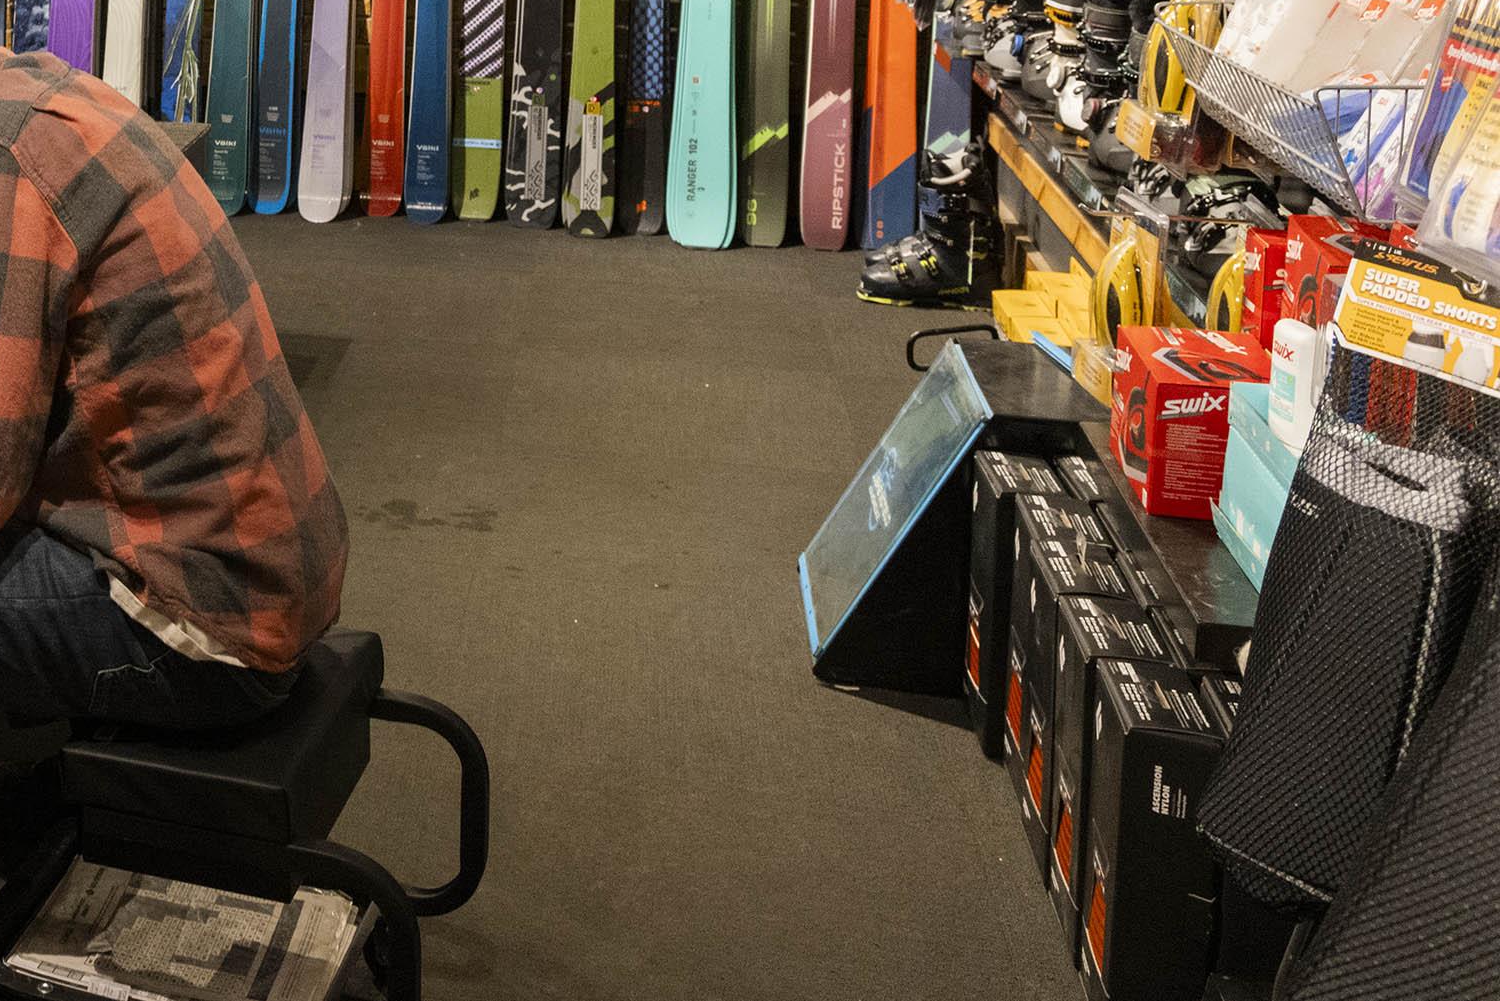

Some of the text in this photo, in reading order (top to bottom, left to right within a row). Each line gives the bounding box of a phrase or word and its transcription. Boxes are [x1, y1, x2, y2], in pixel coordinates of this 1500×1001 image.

[214, 139, 237, 147] Völkl
[371, 138, 395, 147] Völkl
[416, 144, 440, 152] Völkl
[686, 138, 698, 202] RANGER 102
[831, 141, 847, 230] RIPSTICK
[1386, 254, 1440, 275] seirus
[1364, 268, 1421, 294] SUPER
[1360, 280, 1498, 331] PADDED SHORTS
[1273, 340, 1294, 362] swix
[1162, 392, 1227, 416] swix
[1152, 765, 1163, 813] ASCENSION
[1161, 785, 1170, 815] NYLON
